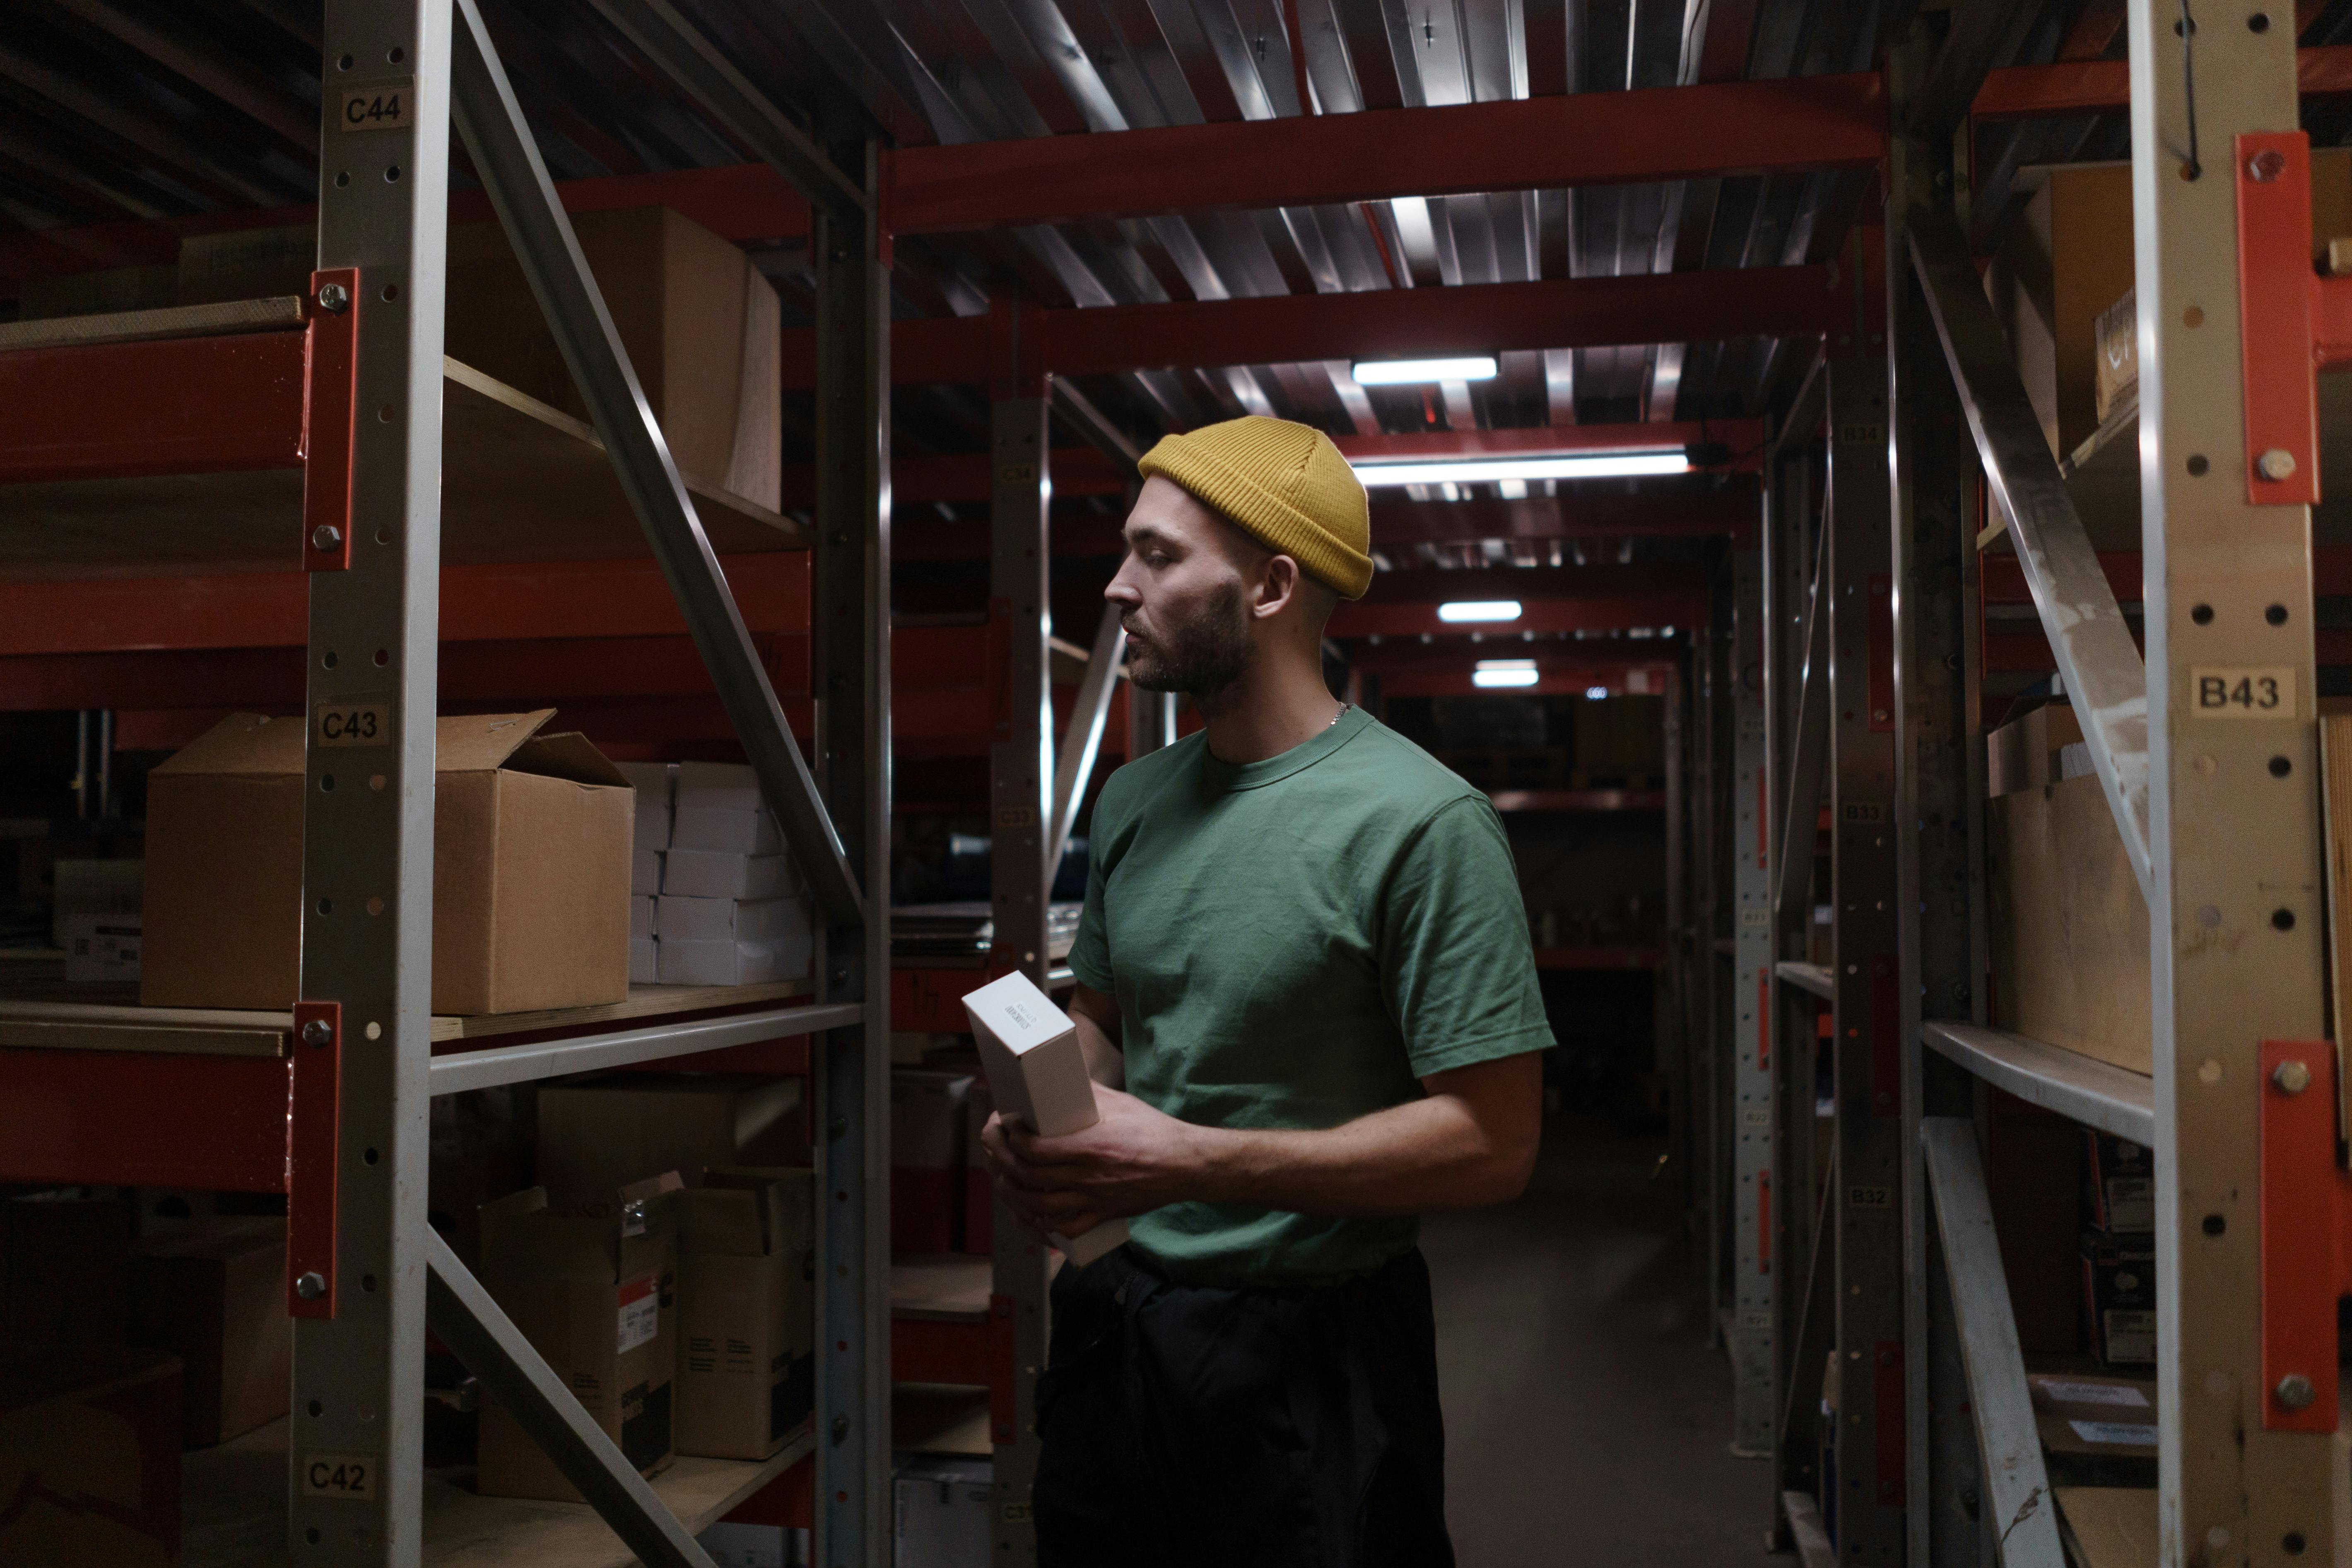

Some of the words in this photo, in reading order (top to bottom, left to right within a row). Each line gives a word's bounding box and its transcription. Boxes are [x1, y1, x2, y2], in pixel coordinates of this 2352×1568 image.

[347, 95, 400, 123] C44
[1845, 427, 1877, 441] B34
[2200, 676, 2279, 710] B43
[323, 712, 377, 739] C43
[1846, 805, 1879, 819] B33
[1852, 1190, 1886, 1204] B32
[309, 1462, 364, 1491] C42
